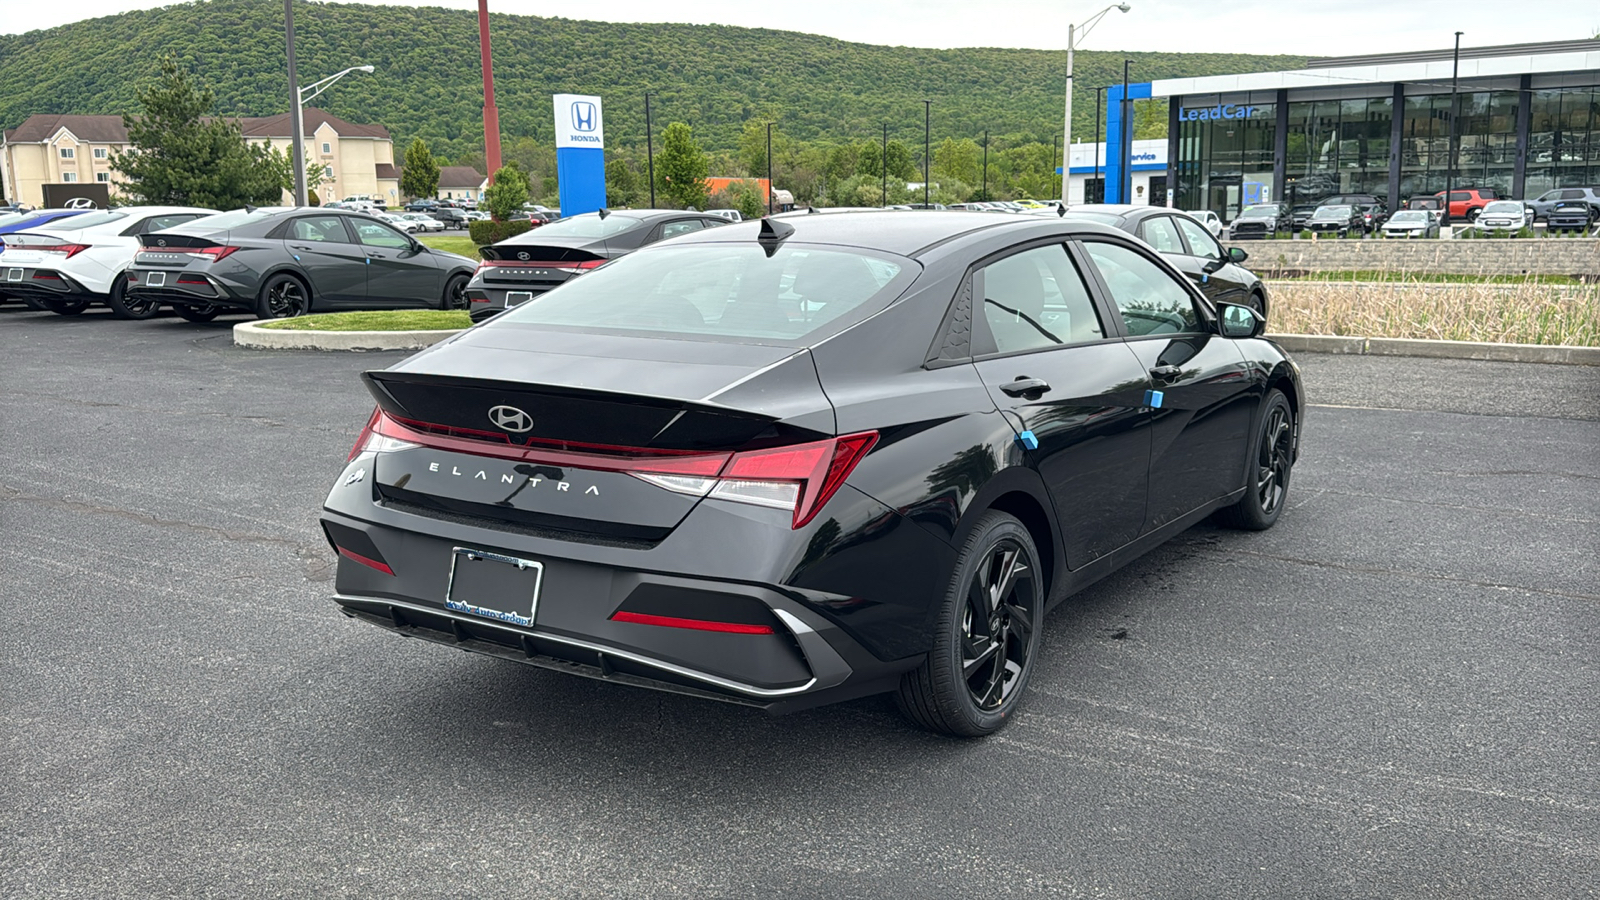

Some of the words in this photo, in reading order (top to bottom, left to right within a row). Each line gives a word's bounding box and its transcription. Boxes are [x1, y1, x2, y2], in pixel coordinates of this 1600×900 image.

[1178, 104, 1254, 121] LeadCar
[1131, 152, 1156, 161] ervice
[428, 462, 600, 496] ELANTRA
[474, 607, 498, 618] Auto
[499, 612, 528, 625] Group
